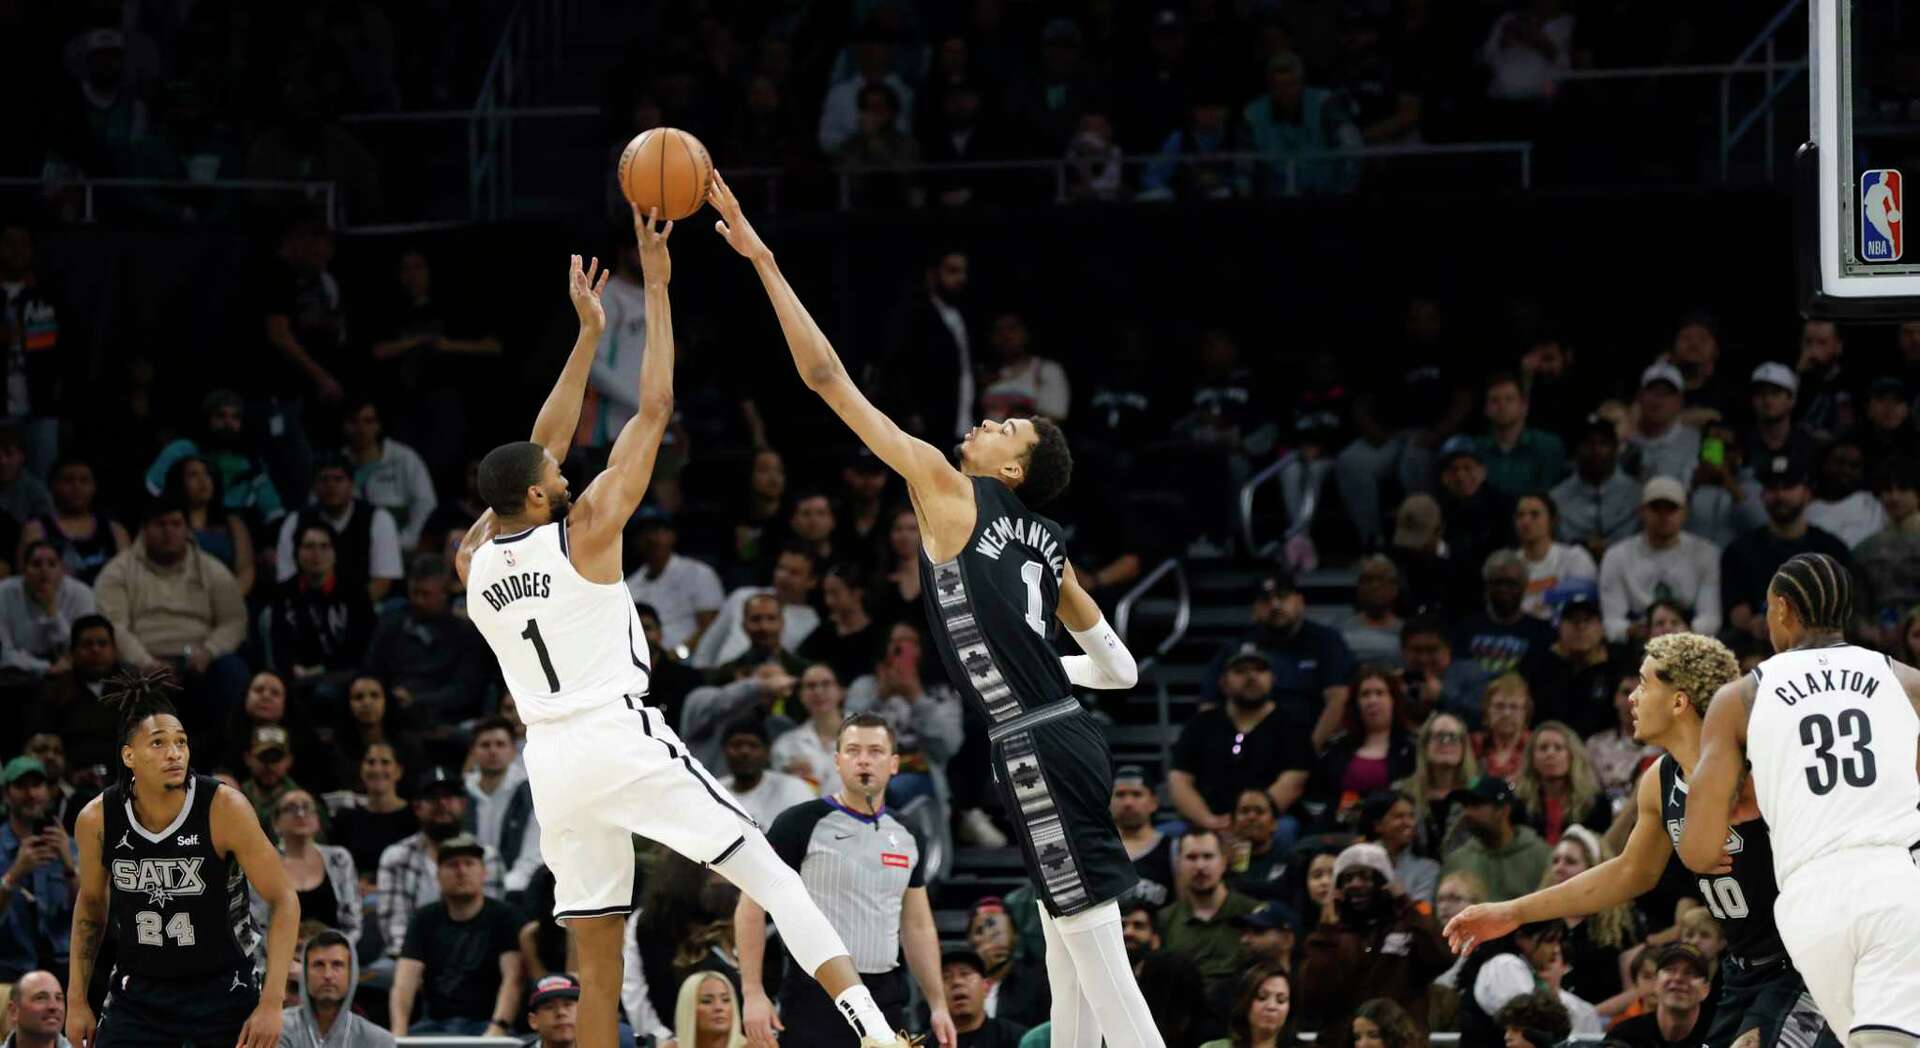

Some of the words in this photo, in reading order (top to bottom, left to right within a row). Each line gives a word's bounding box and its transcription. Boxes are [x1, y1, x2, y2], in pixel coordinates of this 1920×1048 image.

[1868, 240, 1887, 256] NBA
[976, 516, 1063, 587] WEMANYA
[482, 572, 551, 612] BRIDGES
[1021, 560, 1046, 639] 1
[521, 618, 560, 694] 1
[1775, 669, 1880, 706] CLAXTON
[1799, 708, 1877, 796] 33
[112, 857, 206, 896] SATX
[1699, 877, 1749, 919] 10
[135, 911, 195, 947] 24
